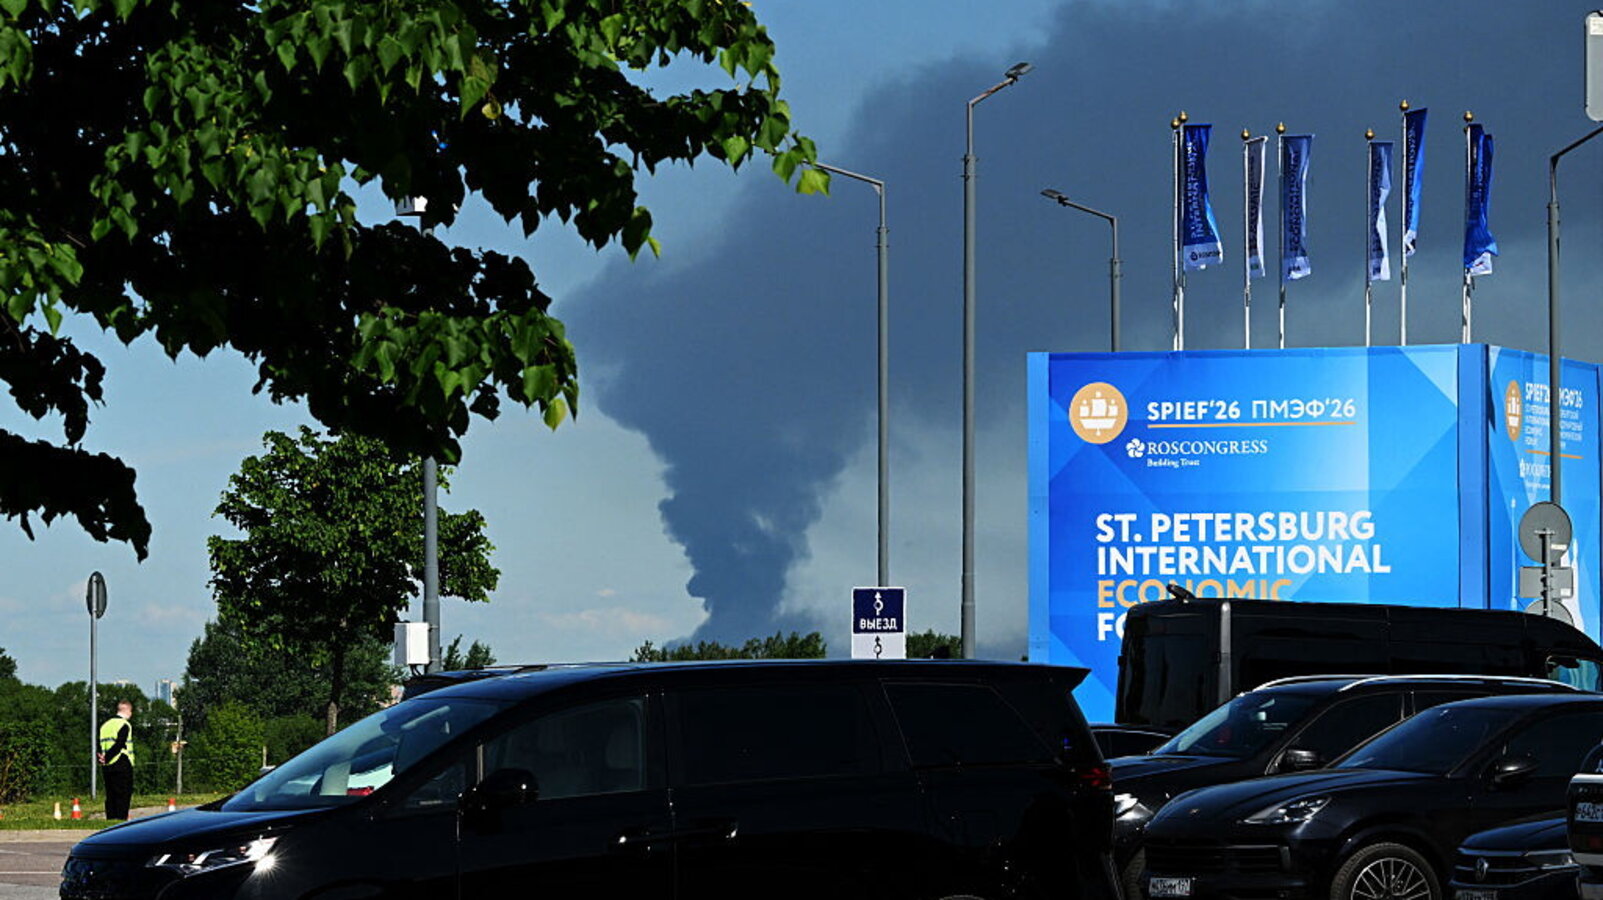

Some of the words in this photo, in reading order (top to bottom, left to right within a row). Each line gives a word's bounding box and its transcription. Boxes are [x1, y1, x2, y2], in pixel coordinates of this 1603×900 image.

[1147, 400, 1240, 420] SPIEF'26
[1252, 398, 1356, 420] ПМЭФ'26
[1147, 440, 1268, 455] ROSCONGRESS
[1147, 458, 1179, 468] Building
[1180, 458, 1200, 466] Trust
[1096, 513, 1142, 542] ST.
[1152, 511, 1375, 541] PETERSBURG
[1098, 544, 1391, 575] INTERNATIONAL
[860, 618, 898, 630] ВЫЕЗД
